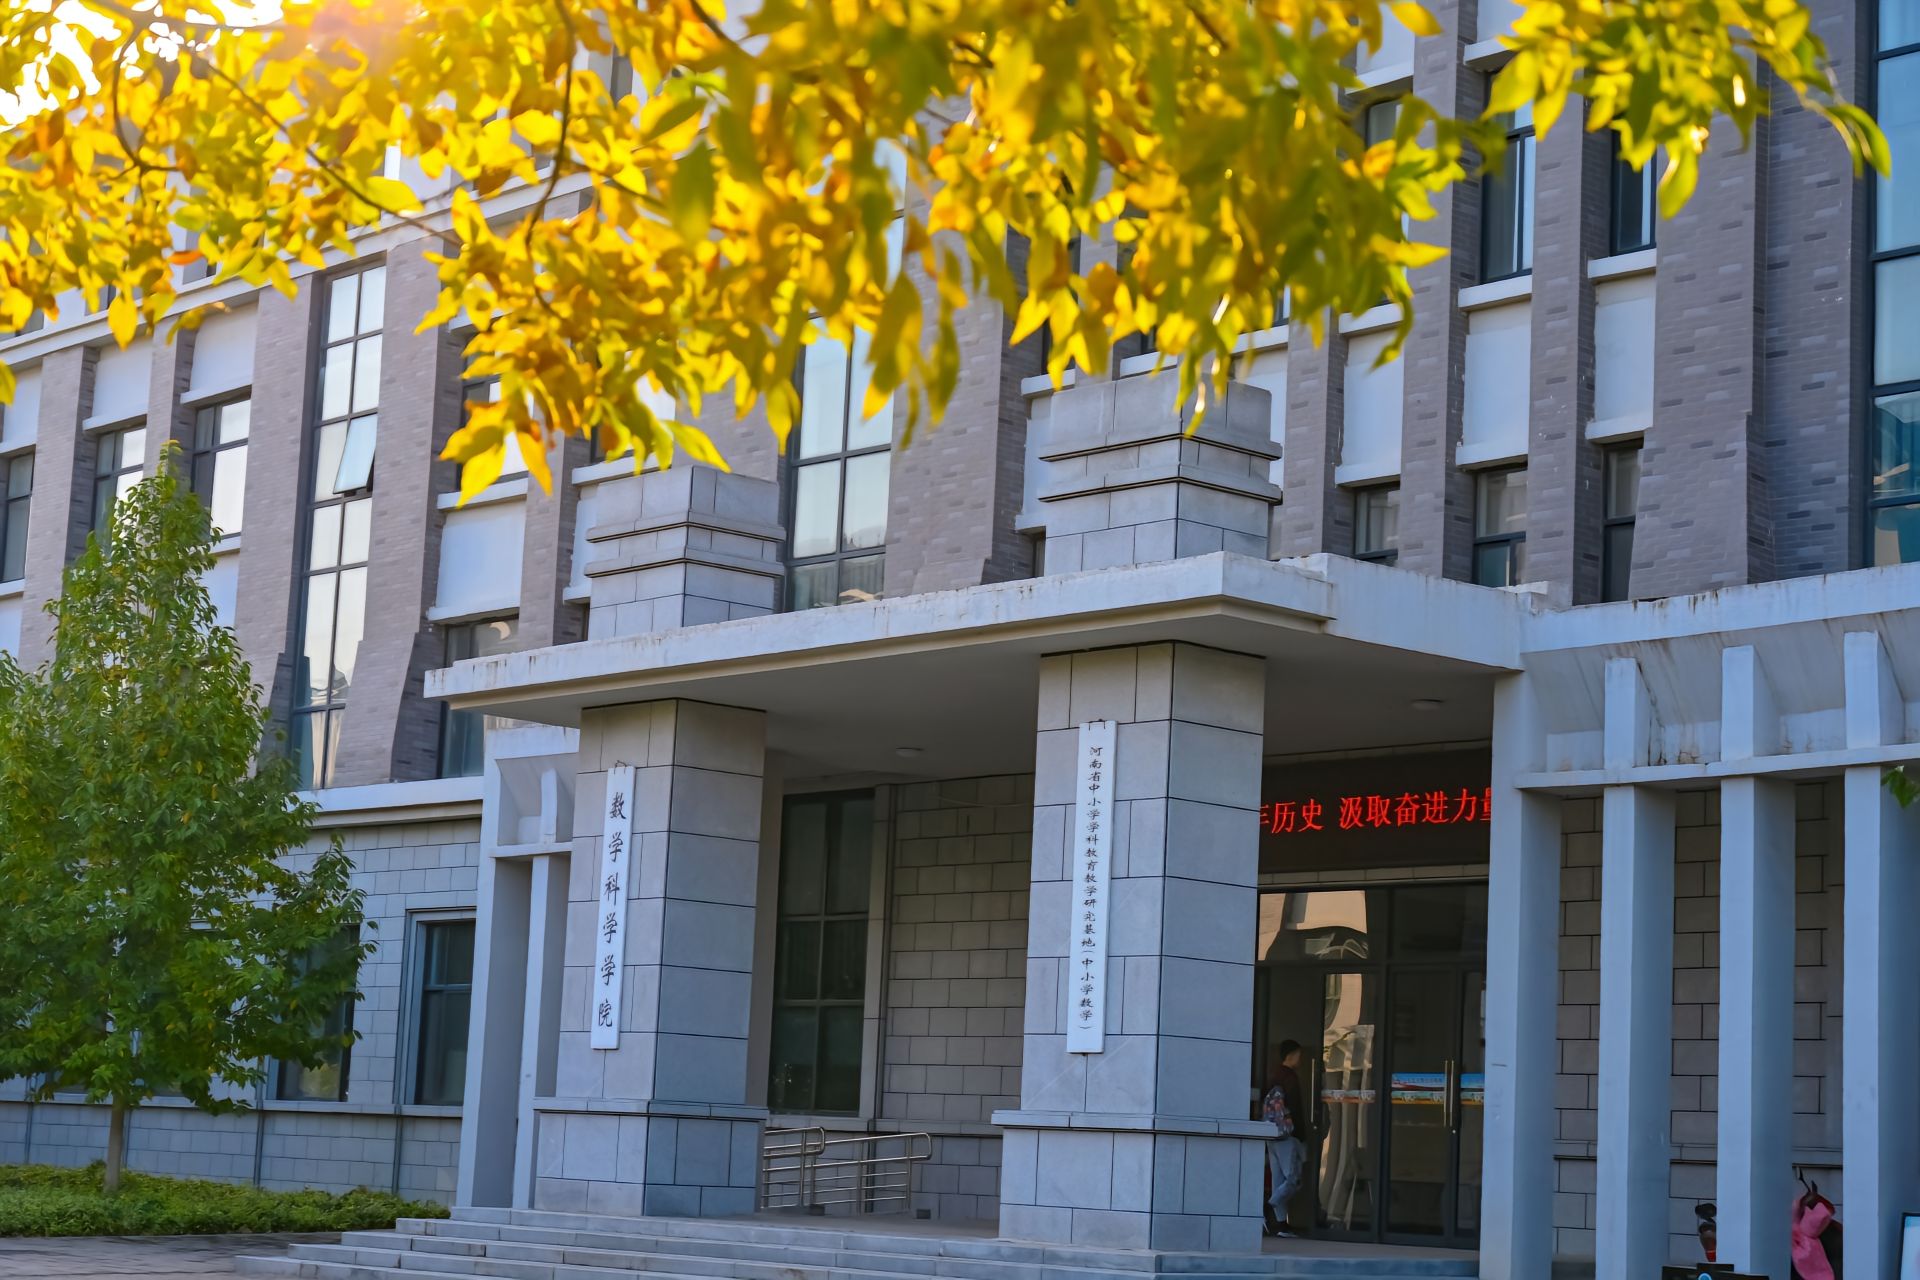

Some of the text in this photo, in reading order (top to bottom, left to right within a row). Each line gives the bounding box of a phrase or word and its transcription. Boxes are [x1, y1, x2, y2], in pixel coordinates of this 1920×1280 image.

[598, 791, 627, 1027] 数学科学学院
